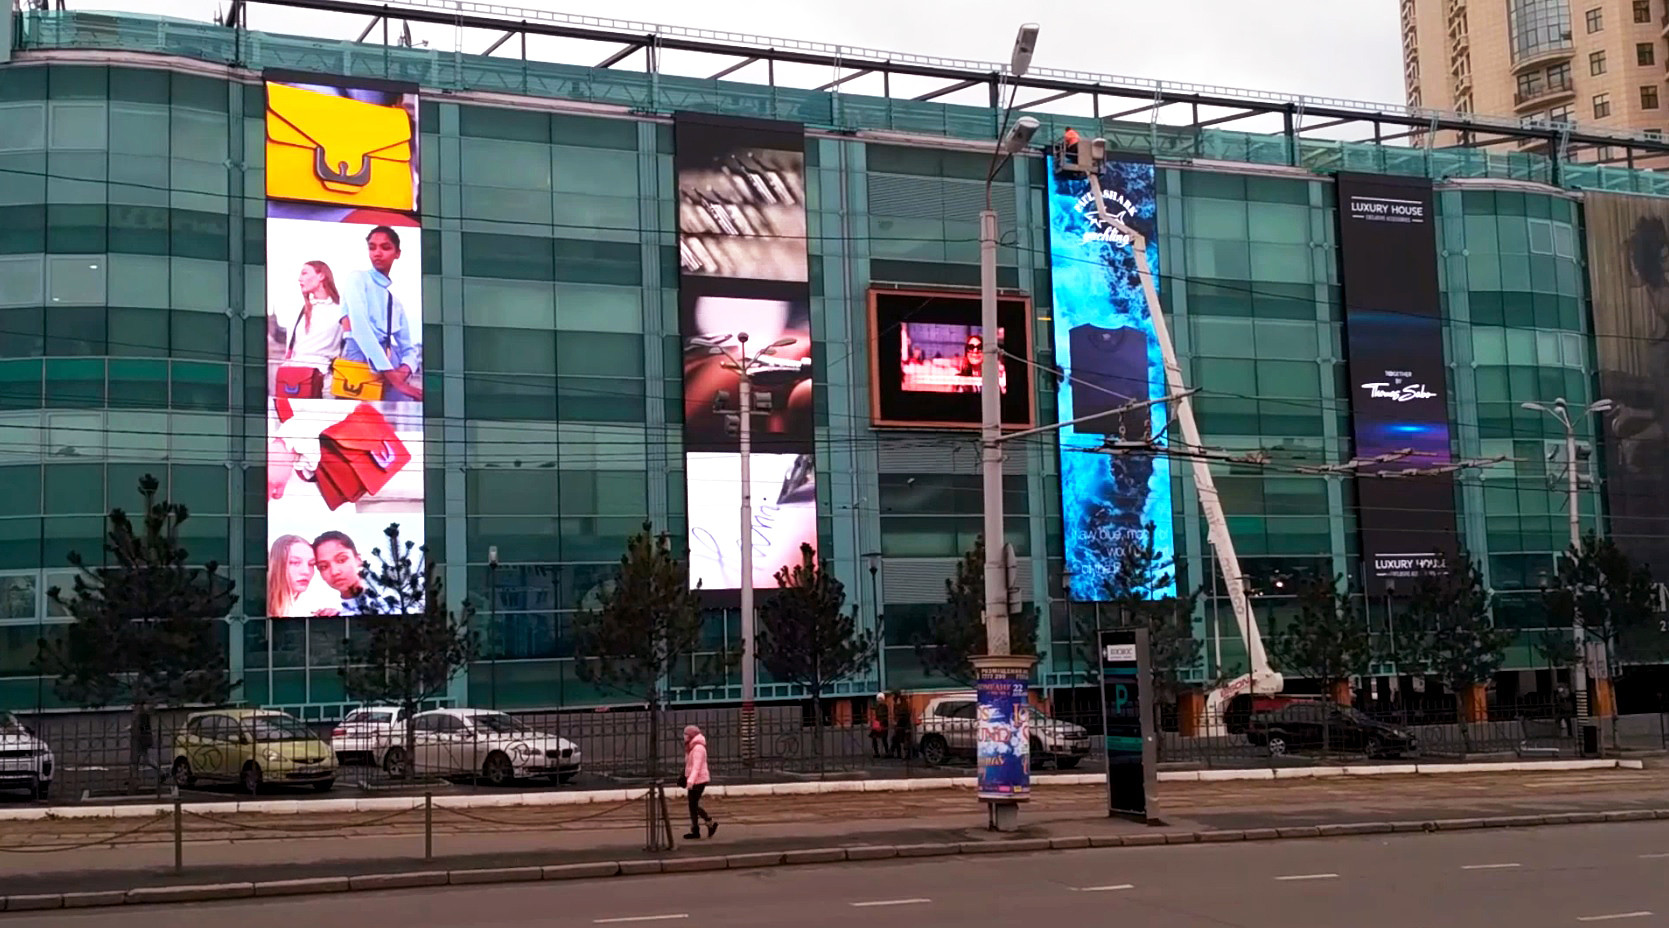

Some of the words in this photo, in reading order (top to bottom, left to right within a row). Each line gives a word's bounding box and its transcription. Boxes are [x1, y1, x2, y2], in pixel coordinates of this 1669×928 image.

[1102, 189, 1138, 217] SHARK
[1351, 202, 1388, 214] LUXURY
[1391, 206, 1423, 216] HOUSE
[1375, 559, 1413, 570] LUXURY
[1012, 683, 1023, 693] 22
[1116, 684, 1128, 714] P
